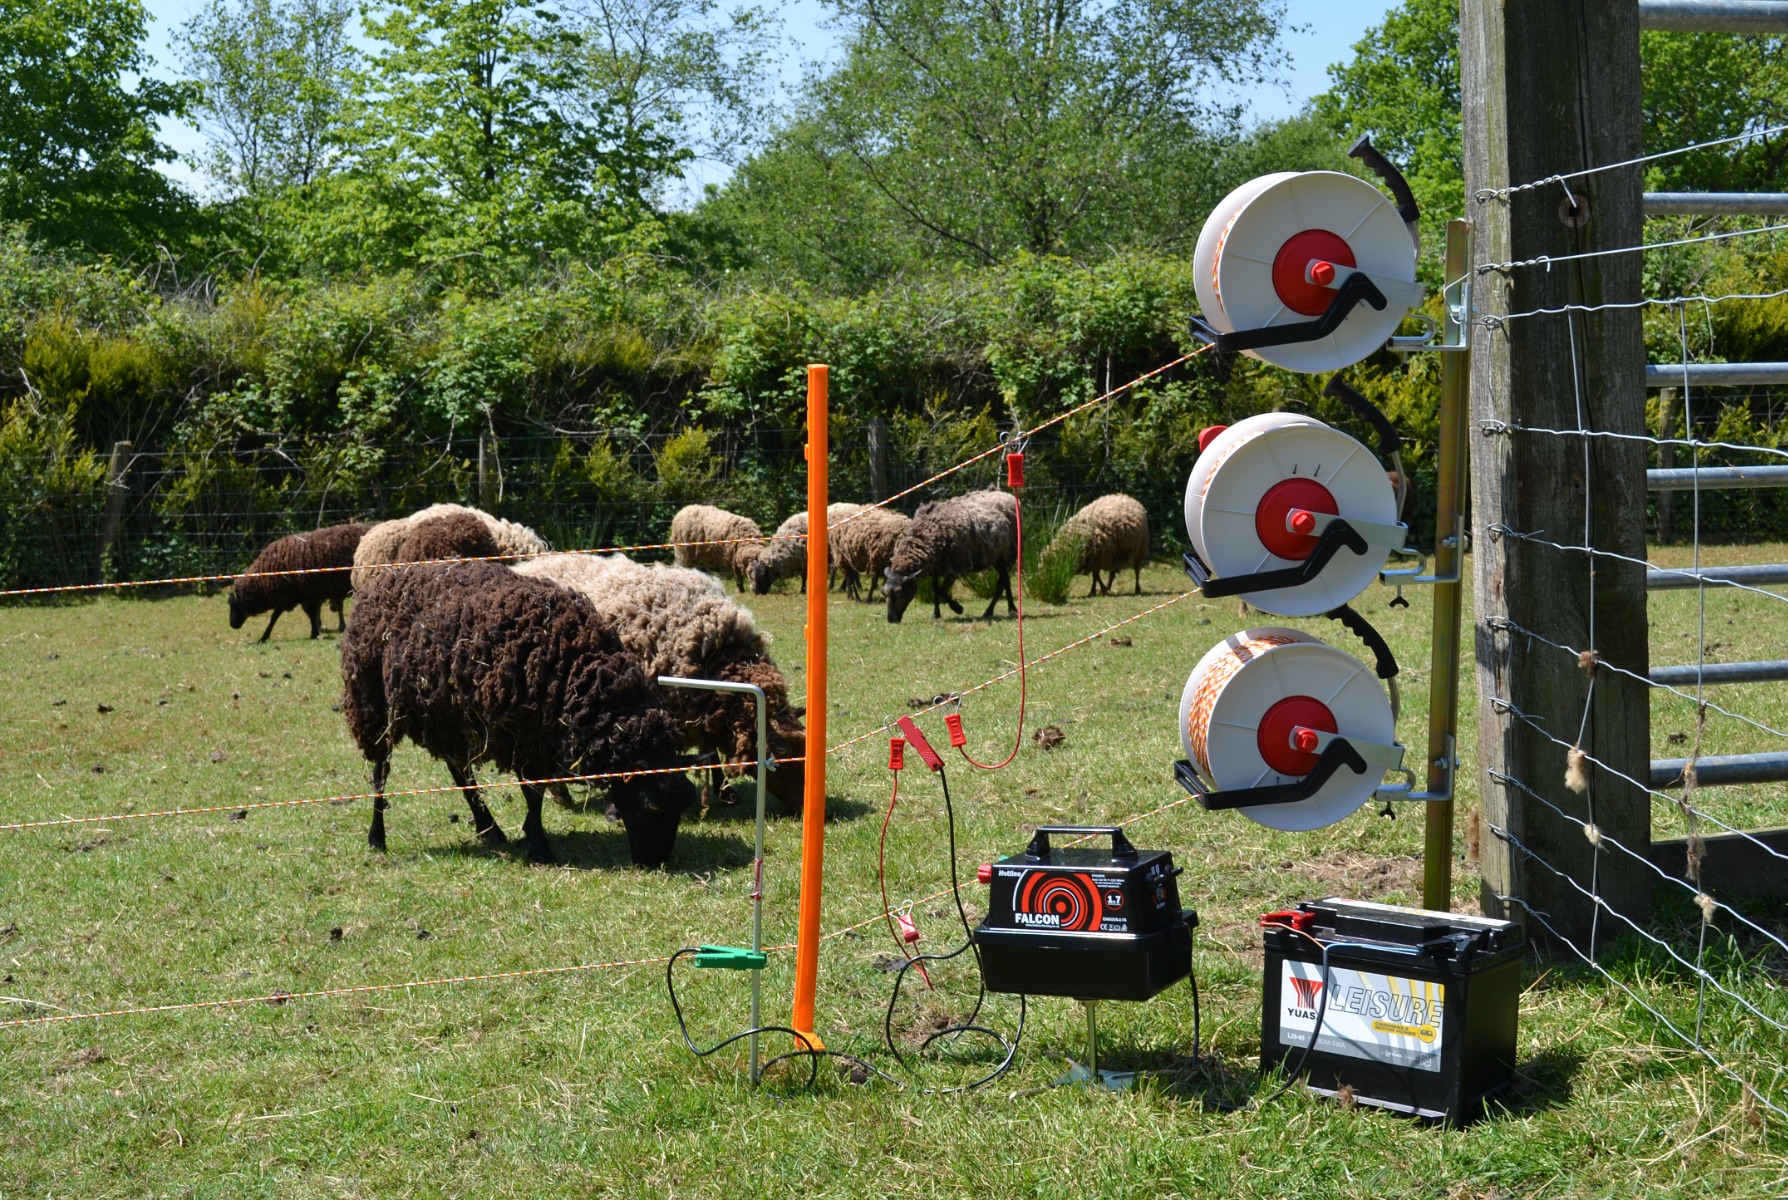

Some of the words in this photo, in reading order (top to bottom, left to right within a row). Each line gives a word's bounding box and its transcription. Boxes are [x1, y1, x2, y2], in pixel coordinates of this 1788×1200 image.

[998, 869, 1022, 877] Hotline
[1107, 895, 1121, 904] 1.7
[1015, 912, 1060, 925] FALCON
[1328, 983, 1444, 1028] LEISURE
[1287, 1007, 1319, 1021] YUAS
